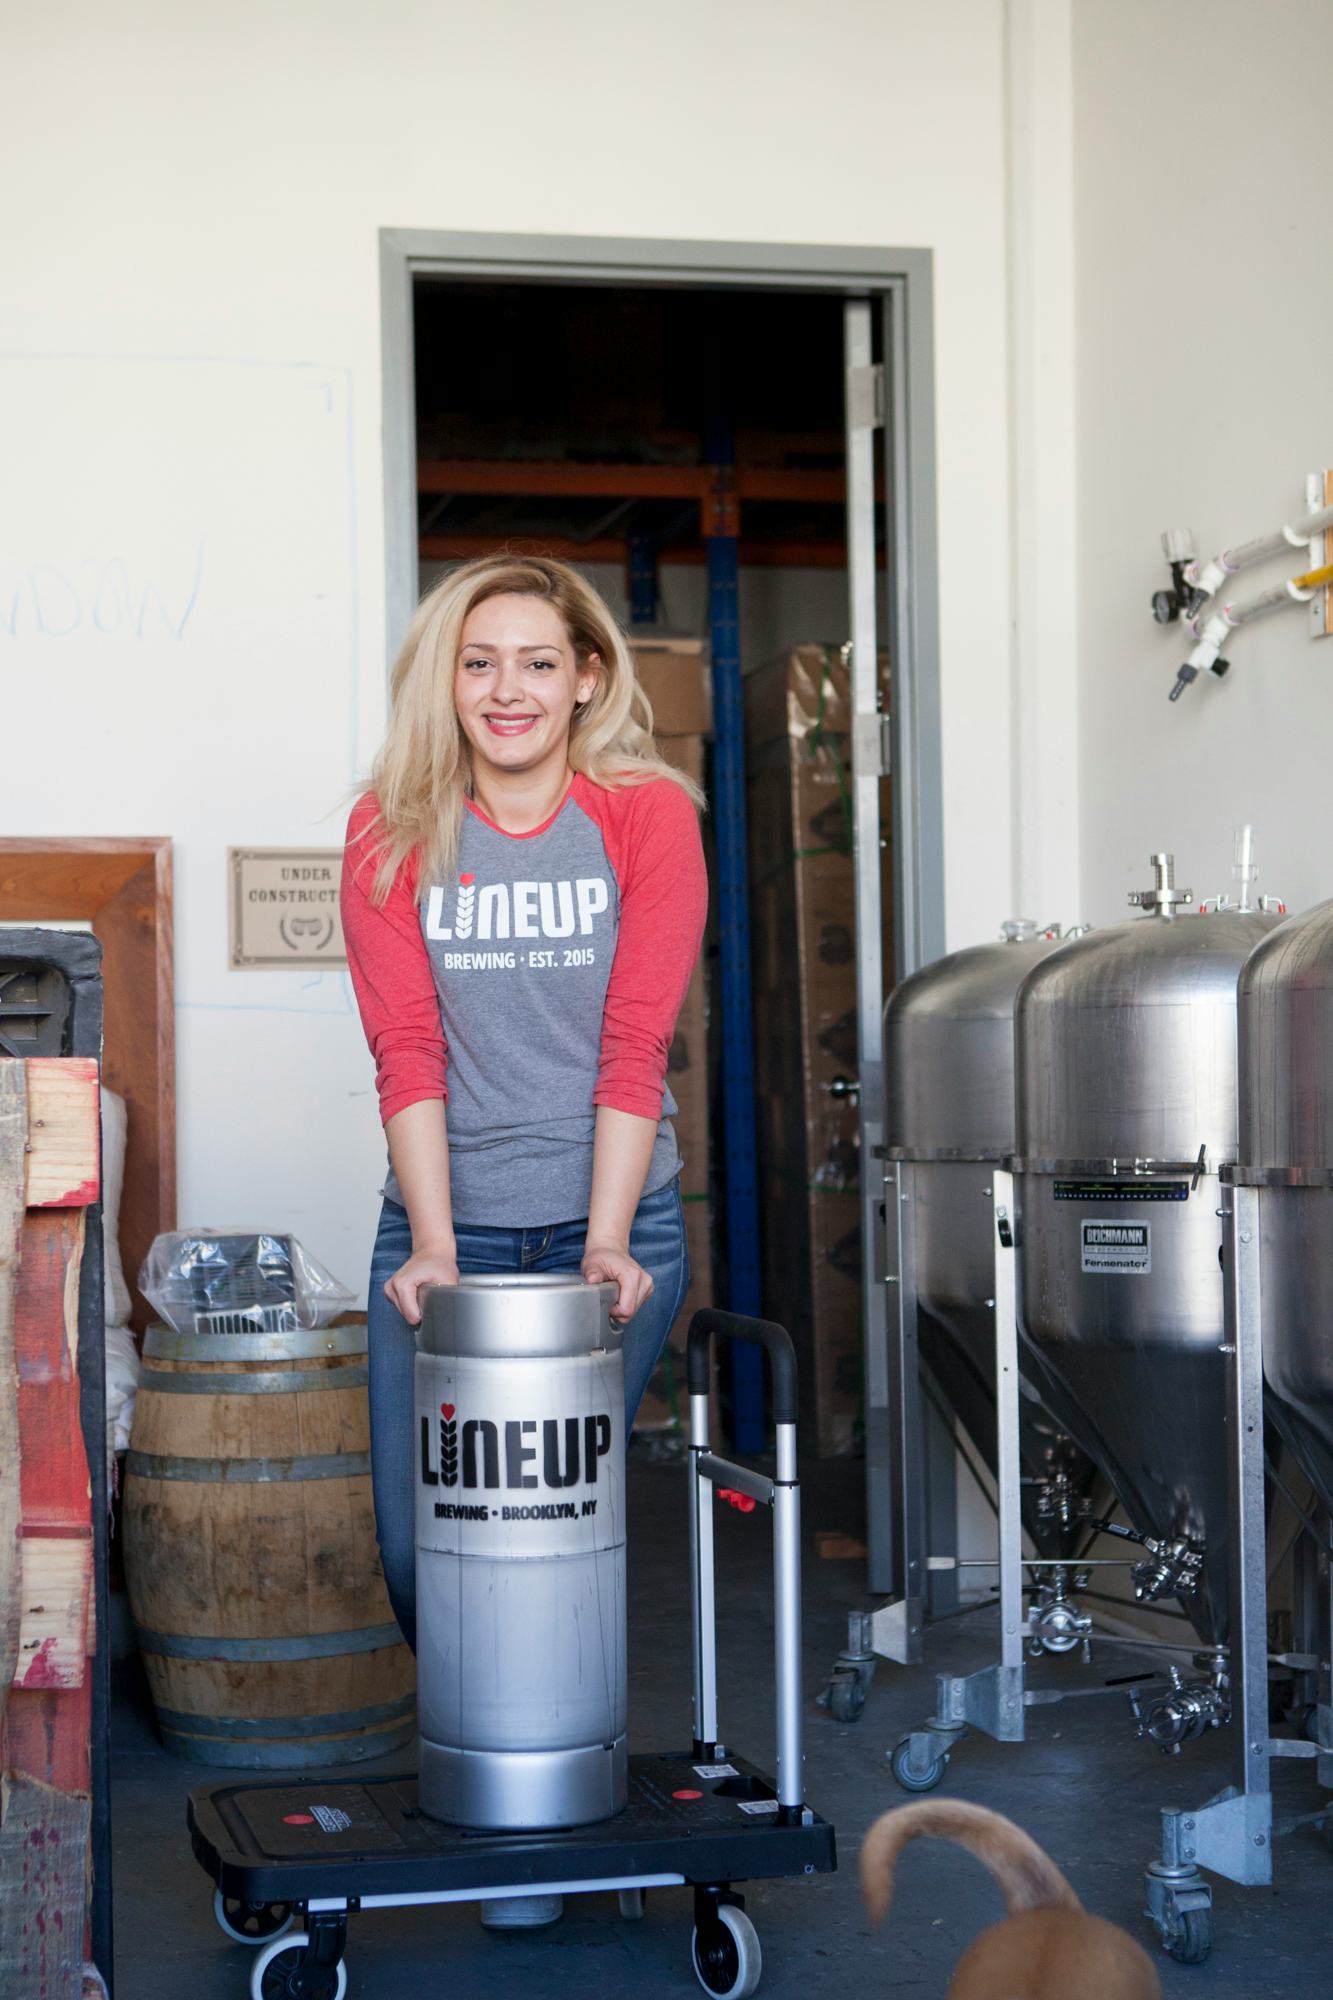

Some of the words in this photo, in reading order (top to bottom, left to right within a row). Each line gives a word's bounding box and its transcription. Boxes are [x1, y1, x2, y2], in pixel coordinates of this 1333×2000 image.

[280, 867, 332, 881] UNDER
[248, 889, 338, 903] CONSTRUCT
[444, 952, 516, 970] BREWING
[529, 951, 559, 968] EST.
[563, 948, 595, 967] 2015
[1084, 1258, 1148, 1268] Fermenator
[434, 1502, 489, 1521] BREWING
[501, 1502, 580, 1521] BROOKLYN,
[582, 1499, 598, 1517] NY
